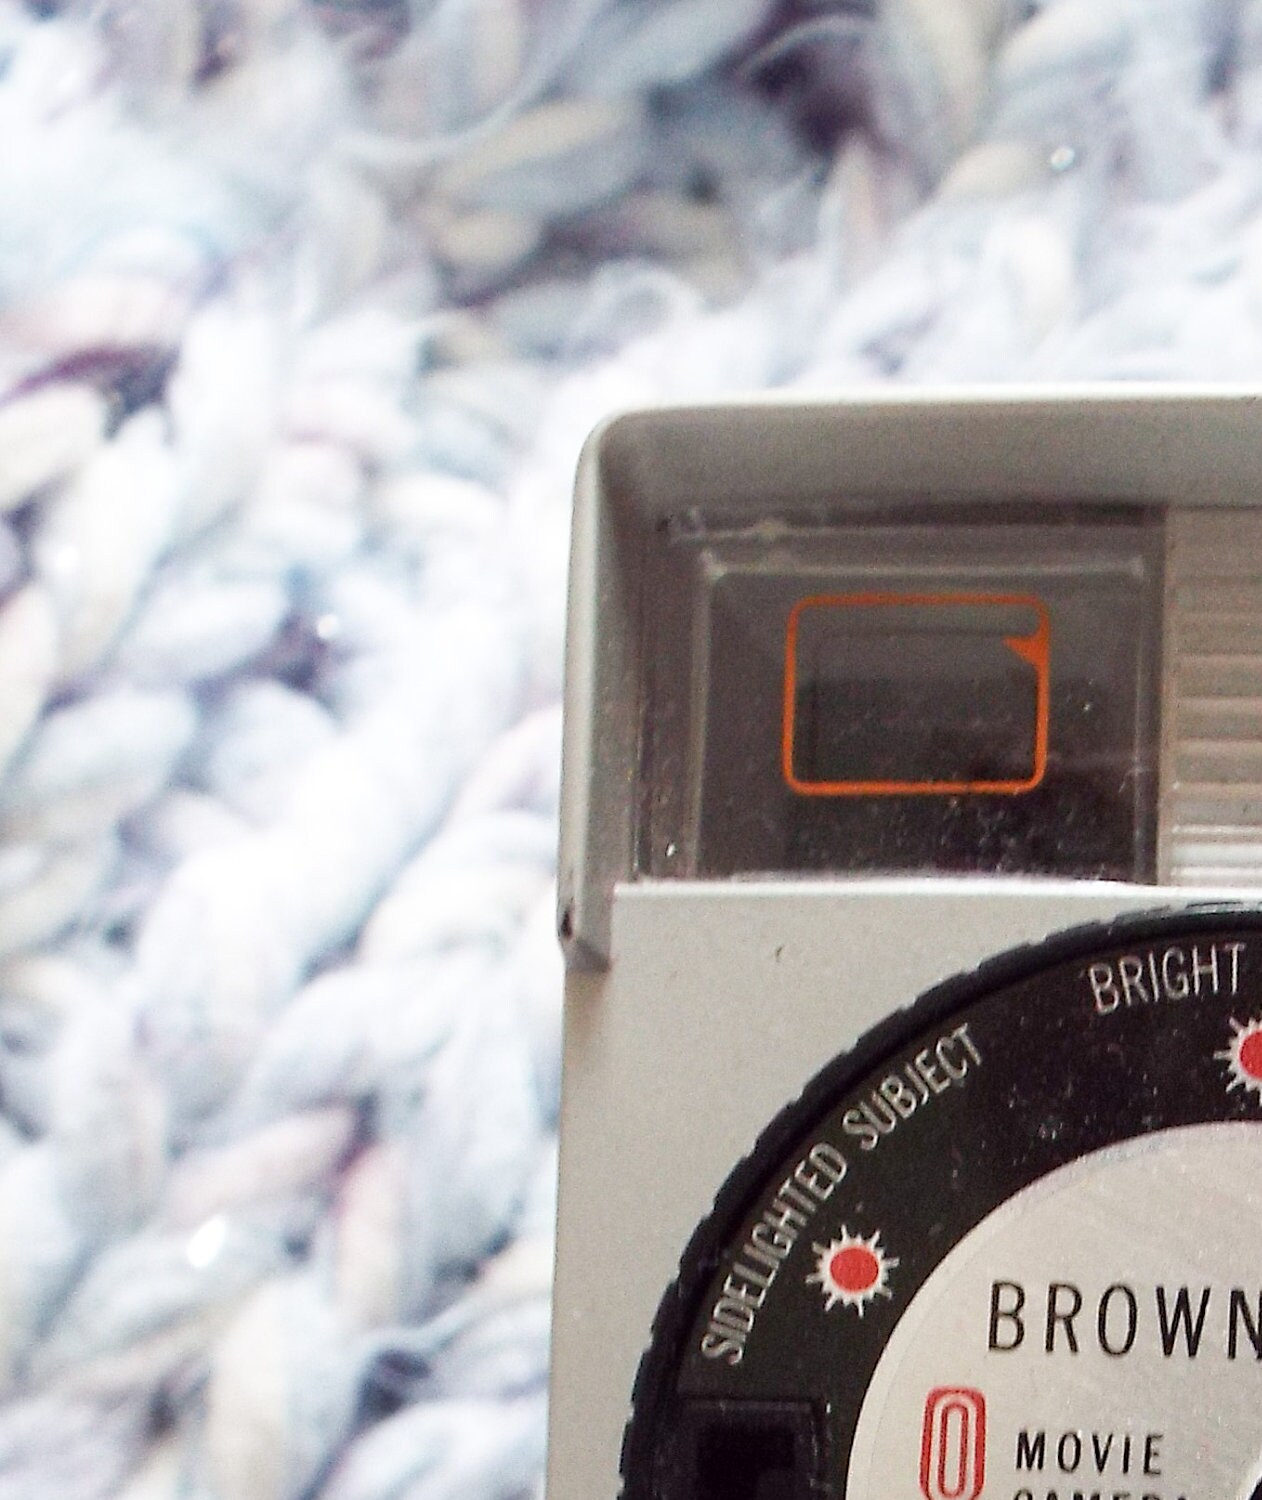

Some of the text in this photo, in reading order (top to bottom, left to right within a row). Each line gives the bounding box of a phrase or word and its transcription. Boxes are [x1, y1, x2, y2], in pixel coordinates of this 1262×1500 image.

[1087, 943, 1247, 1015] BRIGHT
[702, 1022, 982, 1366] SIDELIGHTED SUBJECT
[1016, 1430, 1164, 1476] MOVIE
